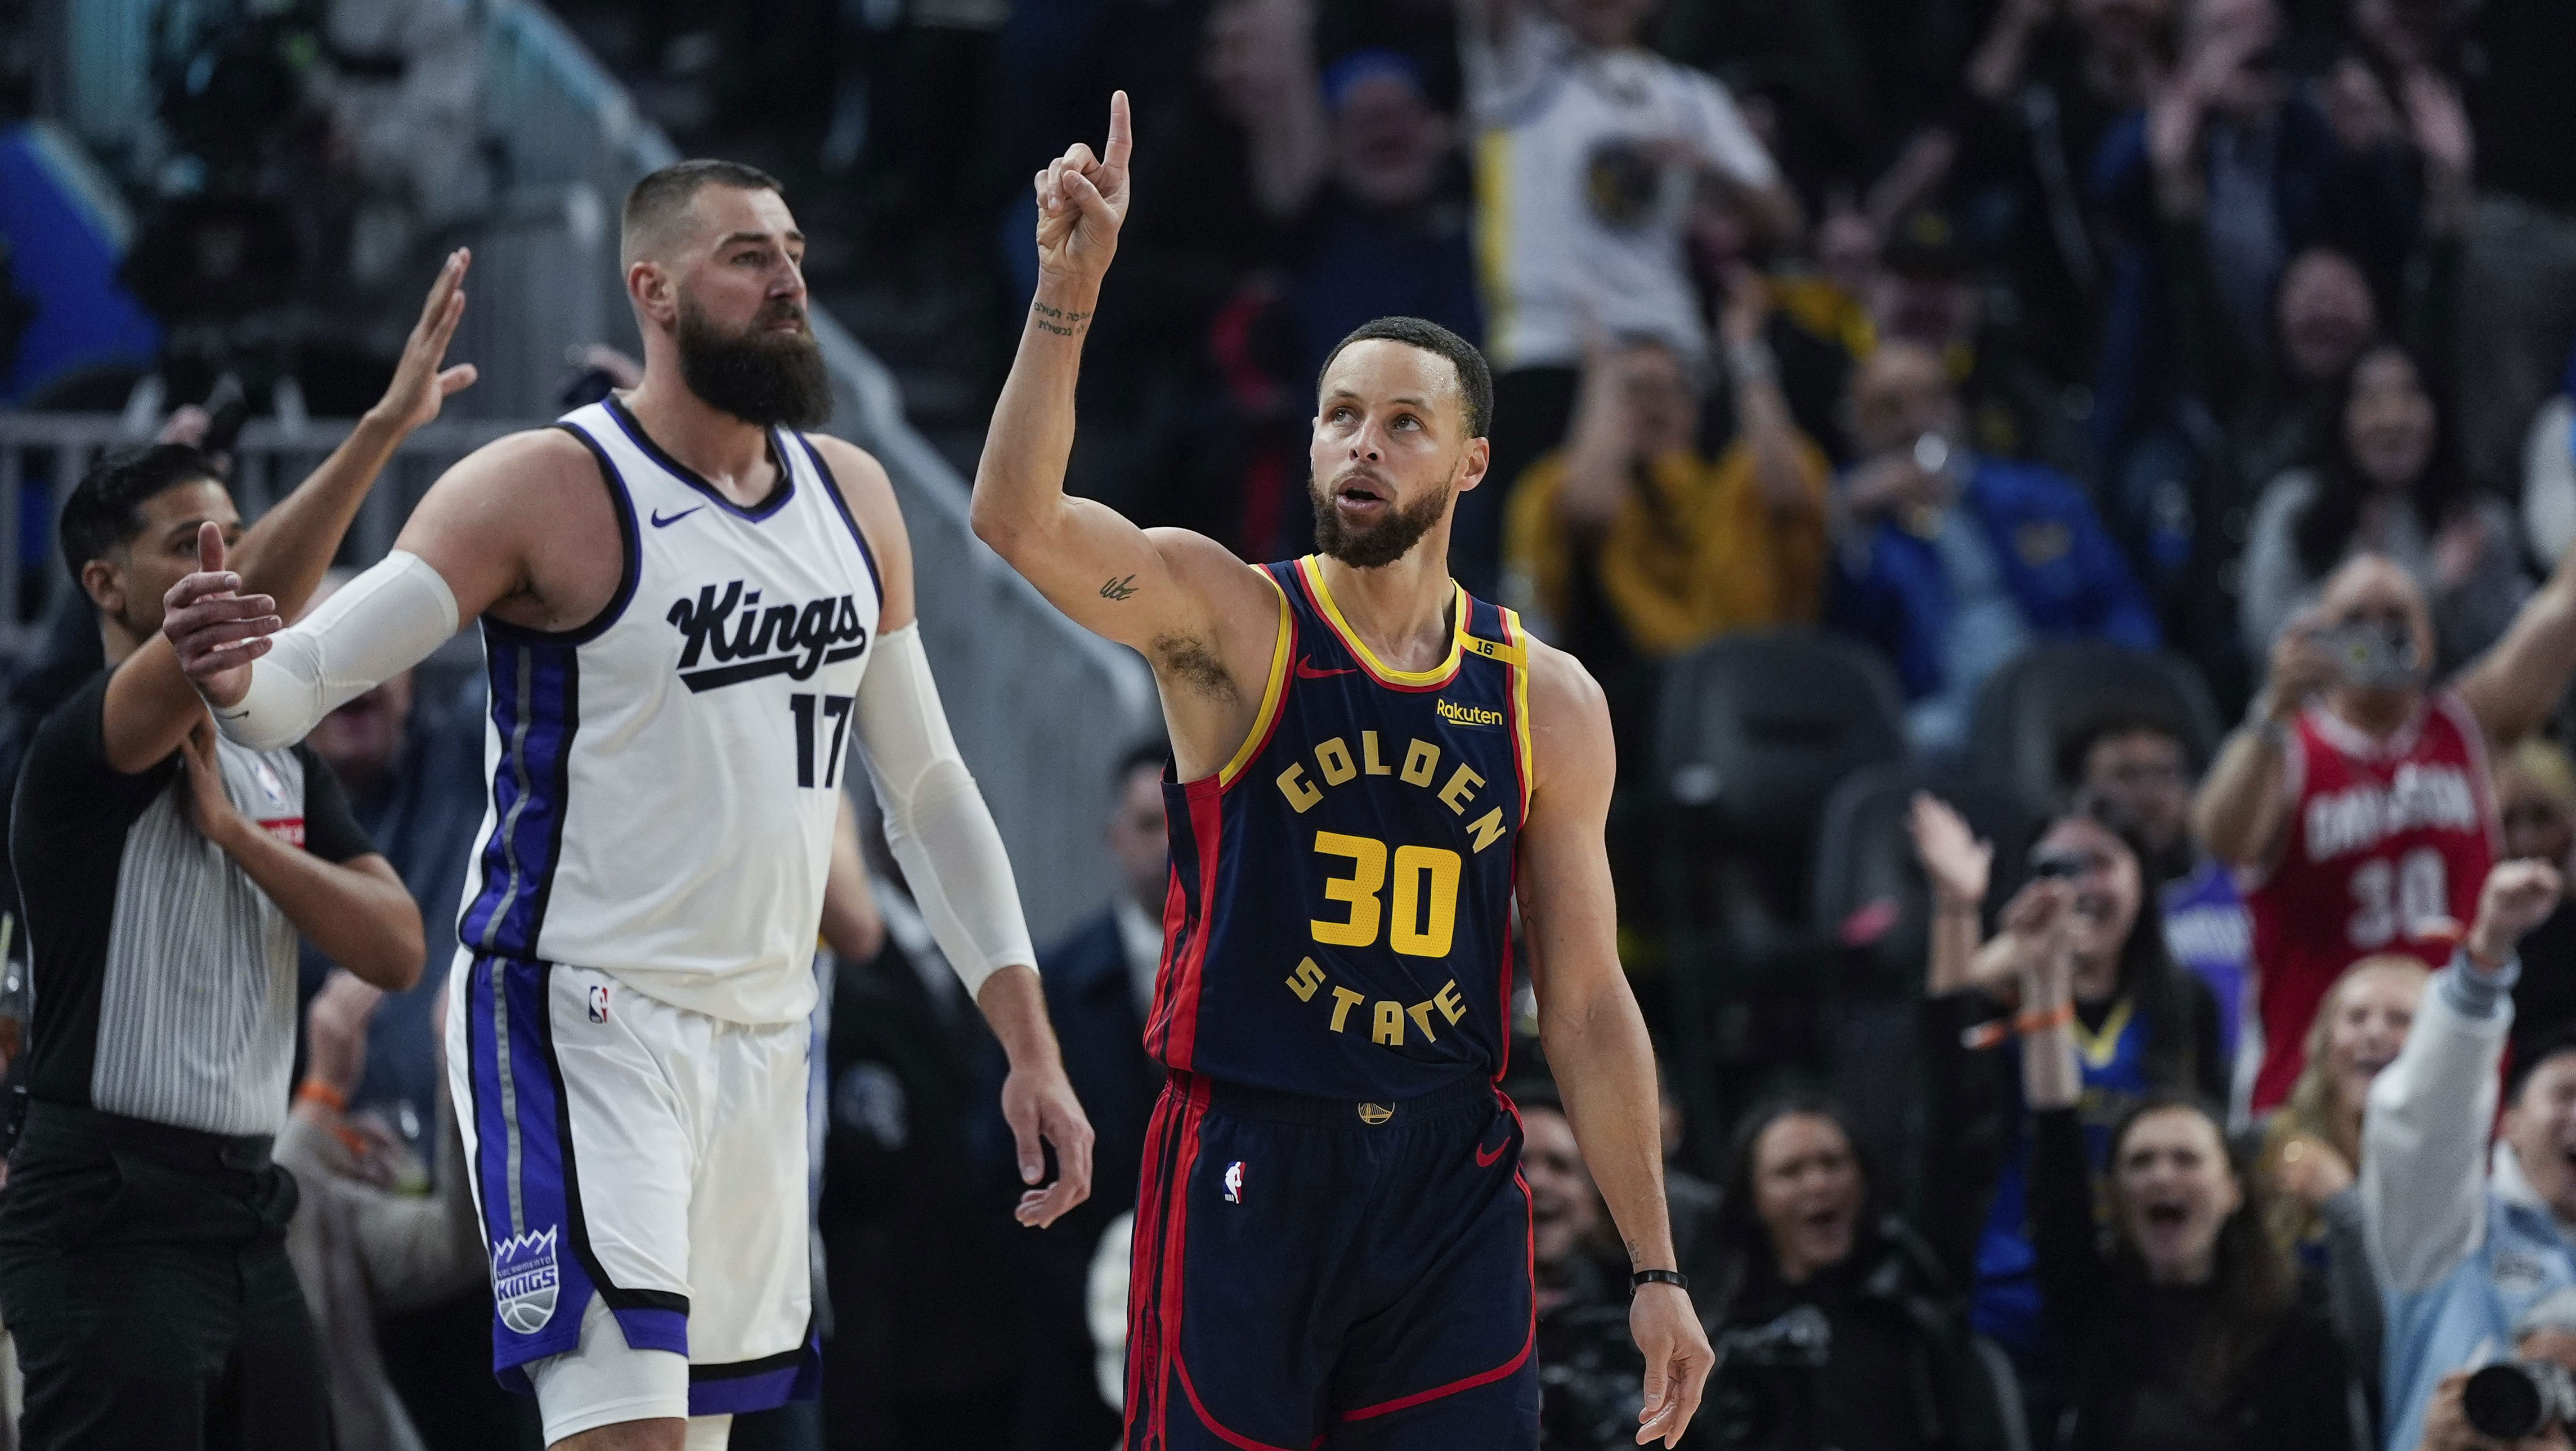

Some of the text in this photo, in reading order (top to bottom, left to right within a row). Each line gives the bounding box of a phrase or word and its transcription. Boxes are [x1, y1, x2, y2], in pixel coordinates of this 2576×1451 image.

[666, 580, 866, 693] Kings
[1476, 641, 1494, 655] 16
[790, 693, 854, 789] 17
[1437, 698, 1503, 726] Rakuten
[1276, 730, 1506, 854] GOLDEN
[1310, 830, 1462, 958] 30
[1285, 956, 1466, 1046] STATE
[1225, 1193, 1235, 1202] NBA
[498, 1269, 556, 1301] KINGS
